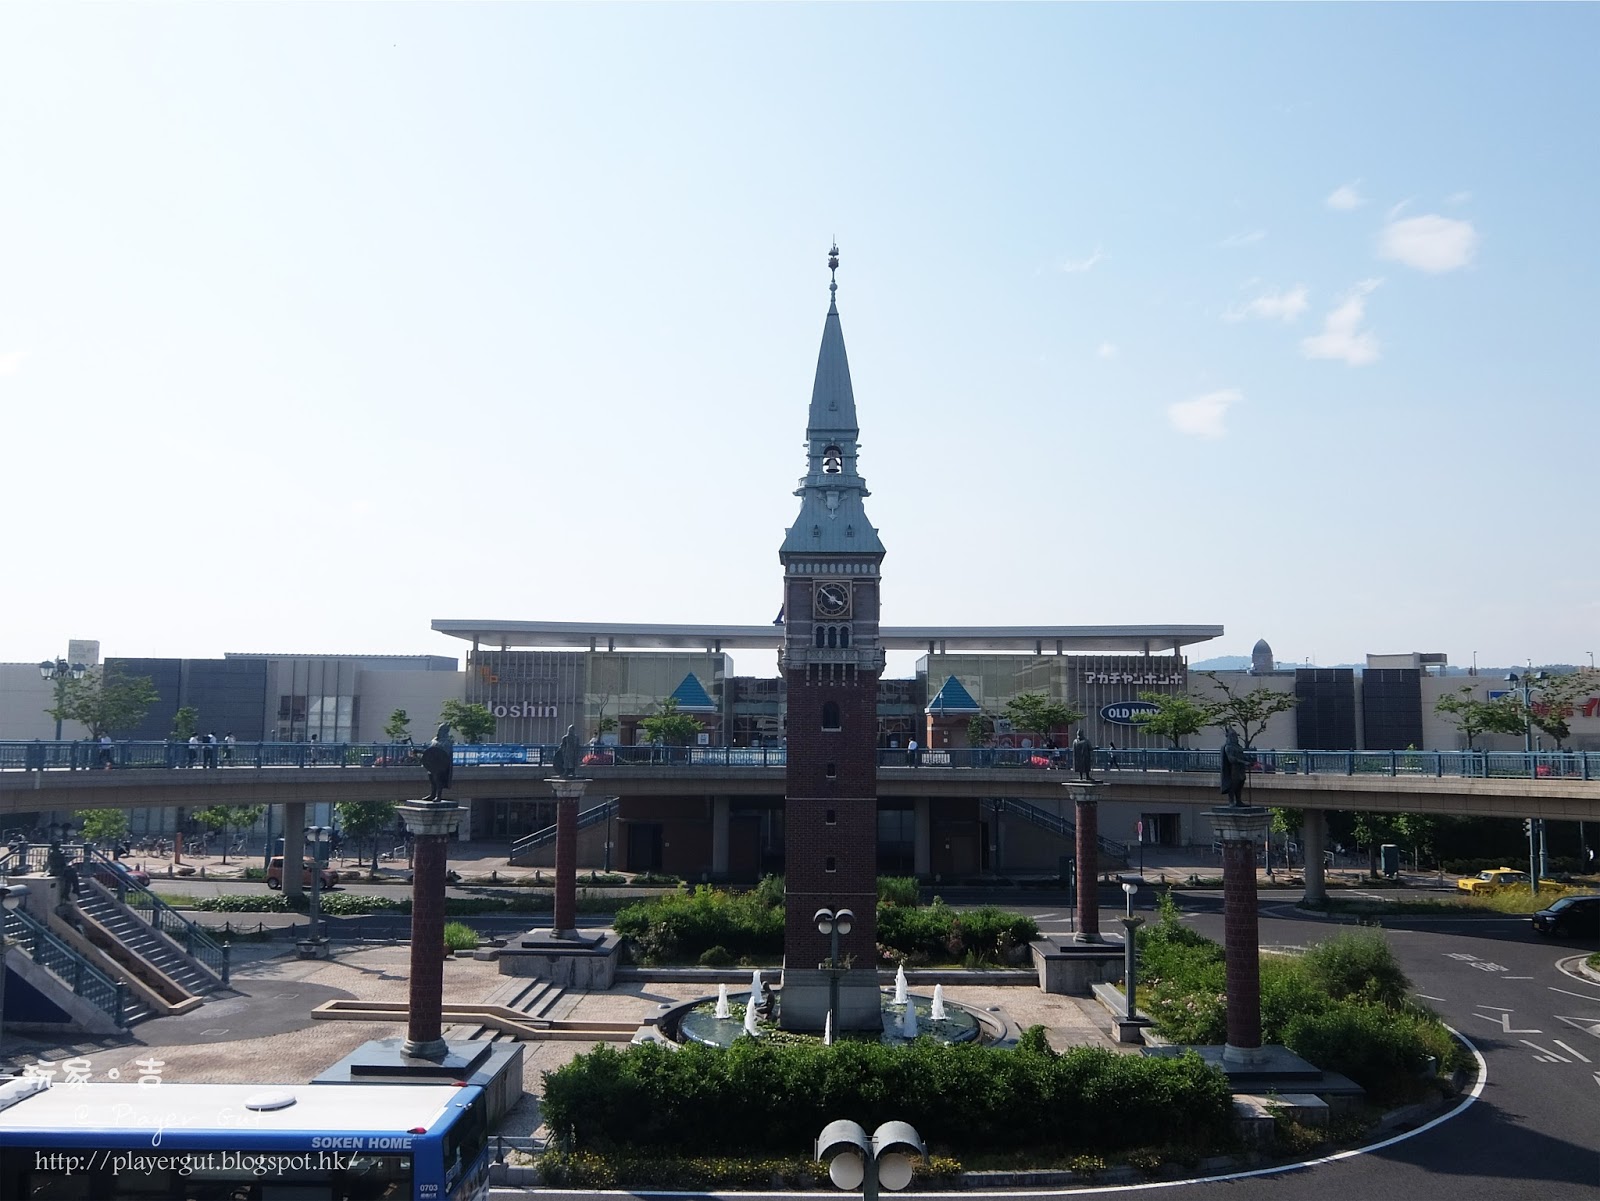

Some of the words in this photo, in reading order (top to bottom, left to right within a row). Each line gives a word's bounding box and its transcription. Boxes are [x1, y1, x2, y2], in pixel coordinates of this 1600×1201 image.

[487, 701, 558, 718] Joshin
[1108, 708, 1130, 718] OLD
[311, 1136, 364, 1149] SOKEN
[368, 1136, 412, 1149] HOME
[419, 1184, 438, 1192] 0703
